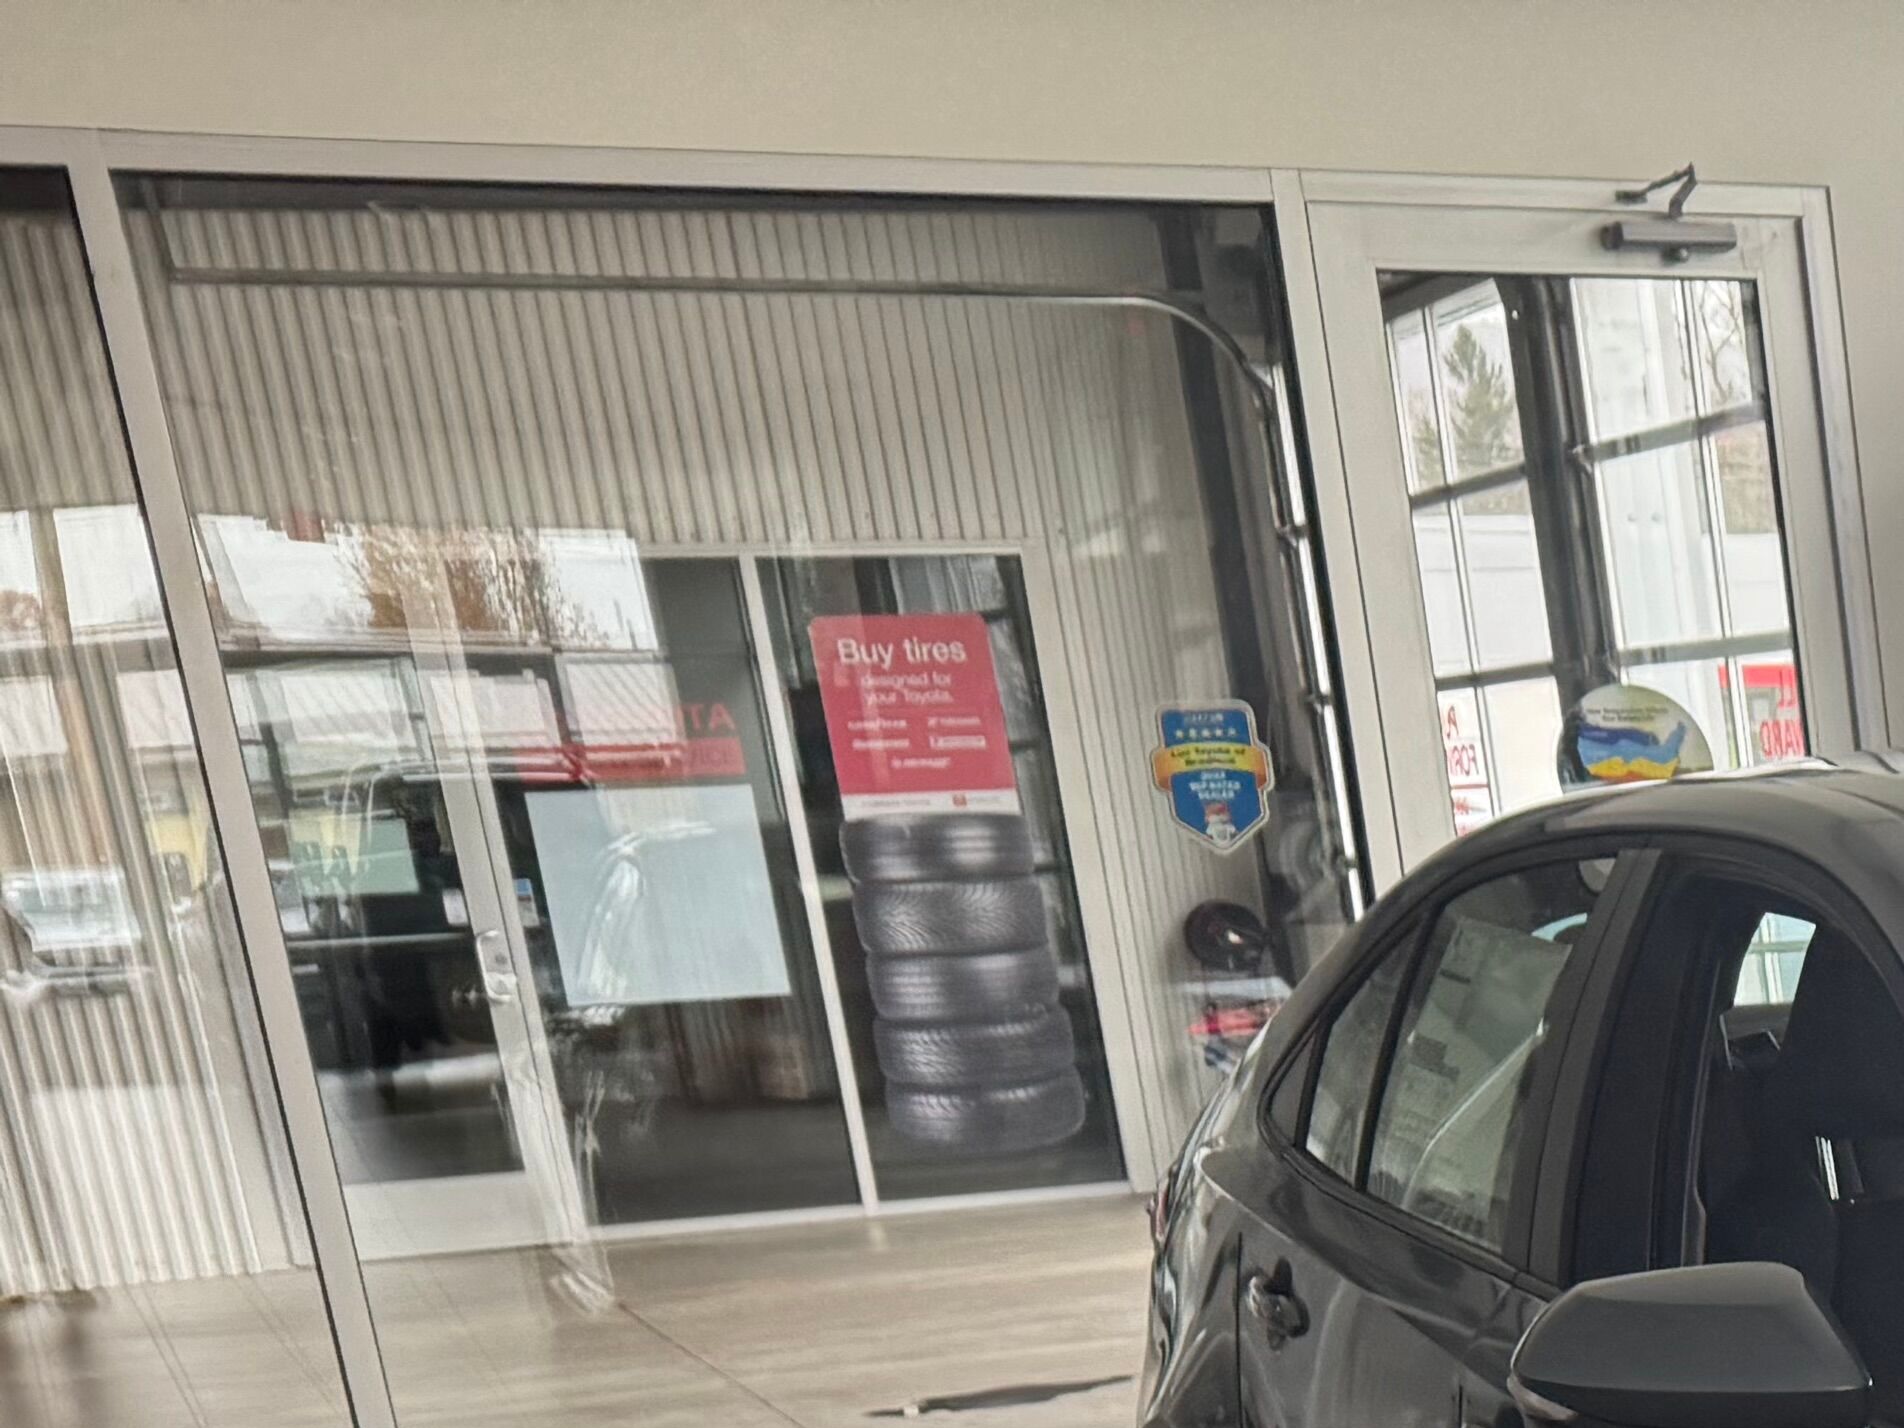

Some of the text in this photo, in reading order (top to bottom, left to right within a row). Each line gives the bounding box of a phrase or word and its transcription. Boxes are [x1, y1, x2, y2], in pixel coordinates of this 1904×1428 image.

[837, 635, 968, 671] Buy tires
[861, 670, 951, 689] designed for
